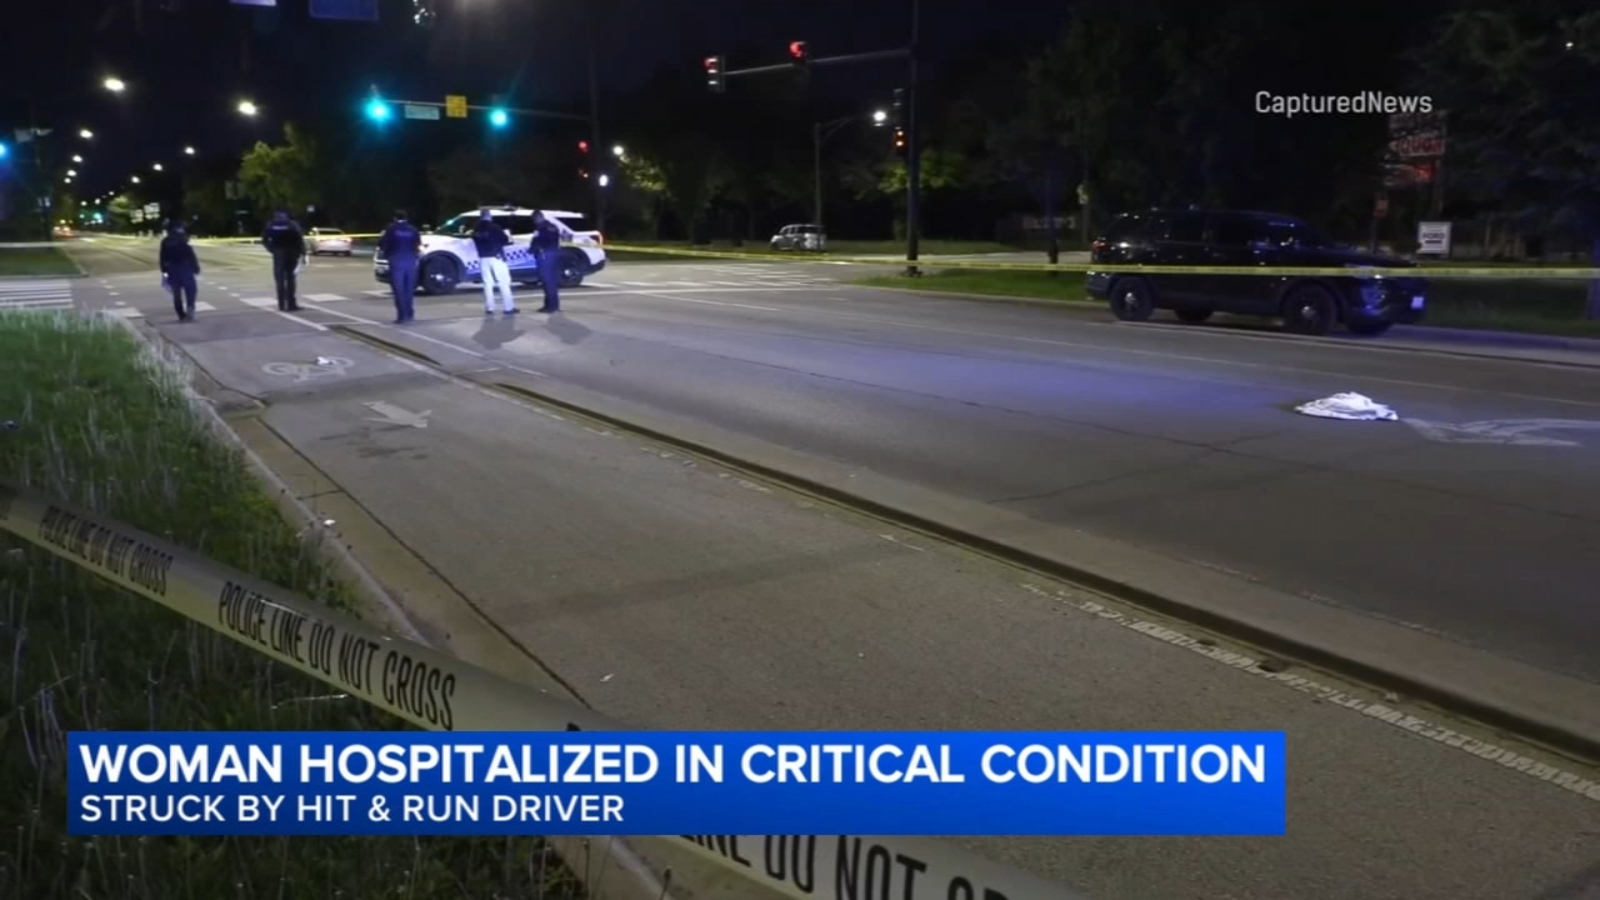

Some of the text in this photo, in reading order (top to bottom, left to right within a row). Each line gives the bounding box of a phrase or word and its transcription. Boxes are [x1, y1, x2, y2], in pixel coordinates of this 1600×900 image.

[105, 534, 136, 578] NOT
[130, 543, 174, 597] CROSS
[218, 581, 456, 732] POLICE LINE DO NOT CROSS
